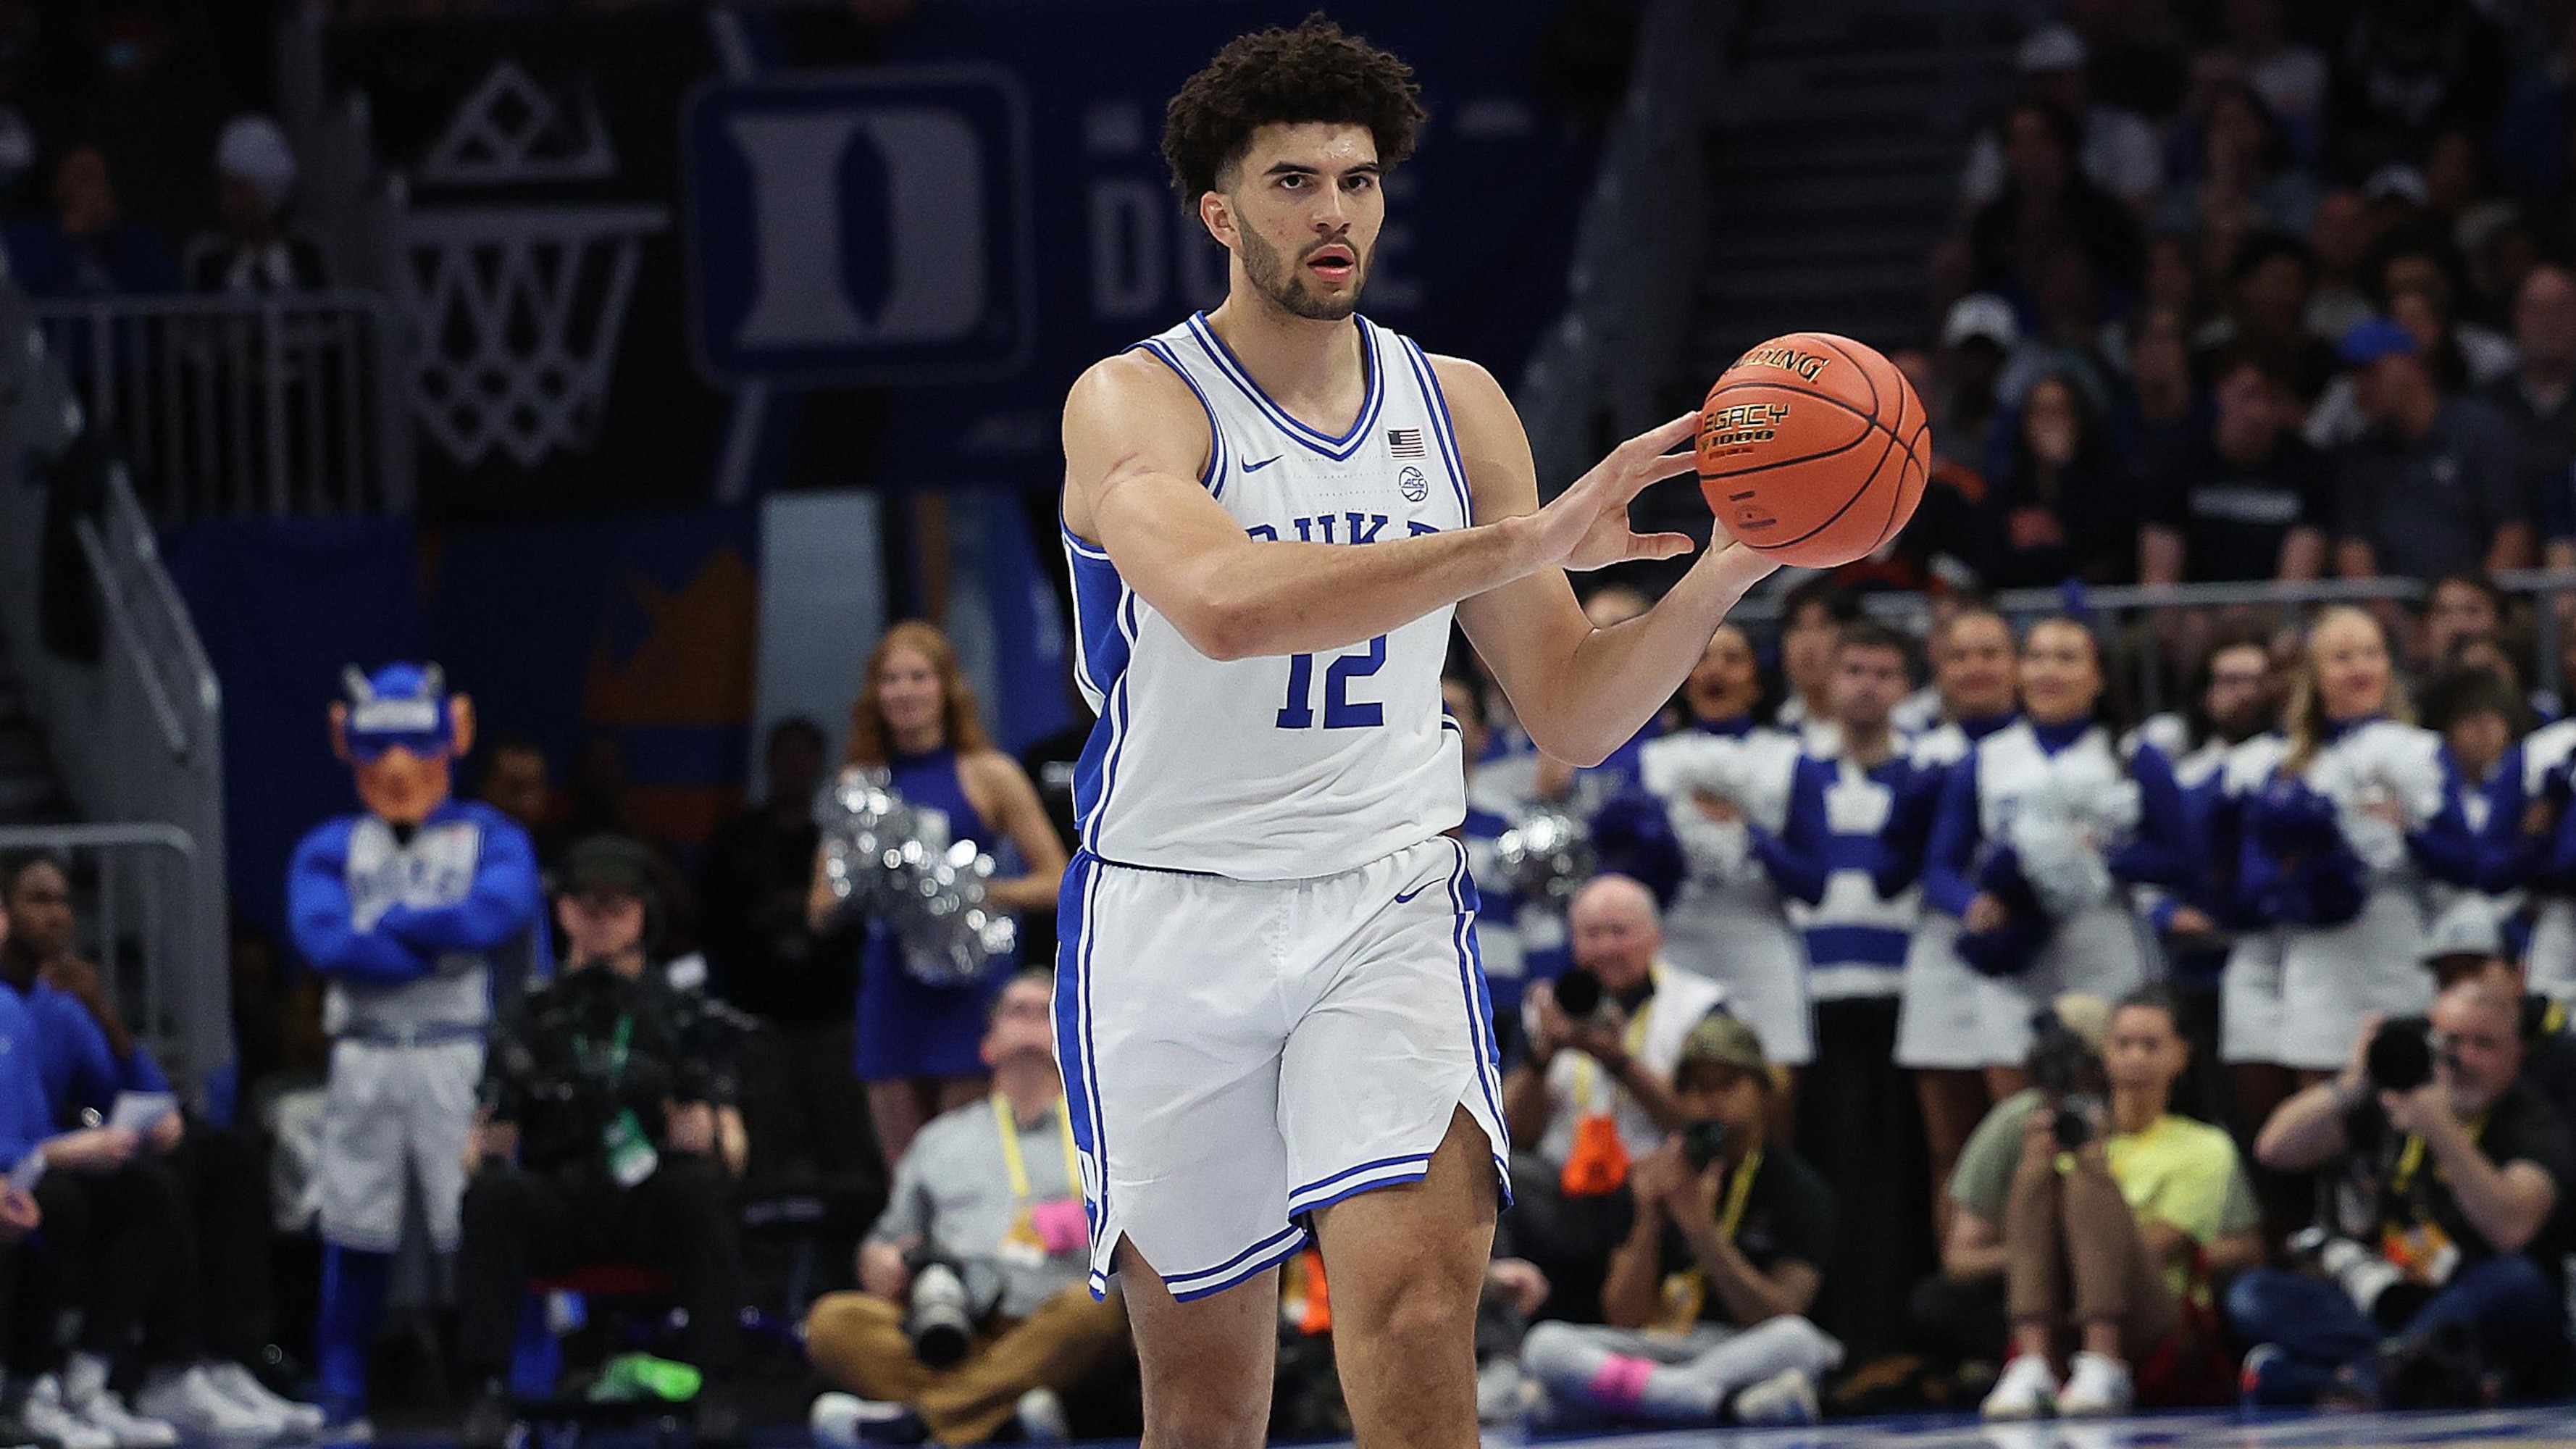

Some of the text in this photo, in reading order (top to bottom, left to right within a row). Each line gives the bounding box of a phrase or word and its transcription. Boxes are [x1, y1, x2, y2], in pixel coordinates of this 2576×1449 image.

[727, 107, 985, 349] D
[1091, 181, 1422, 320] DUE
[1741, 348, 1830, 383] DING
[1703, 404, 1790, 434] EGACY
[1276, 634, 1385, 729] 12
